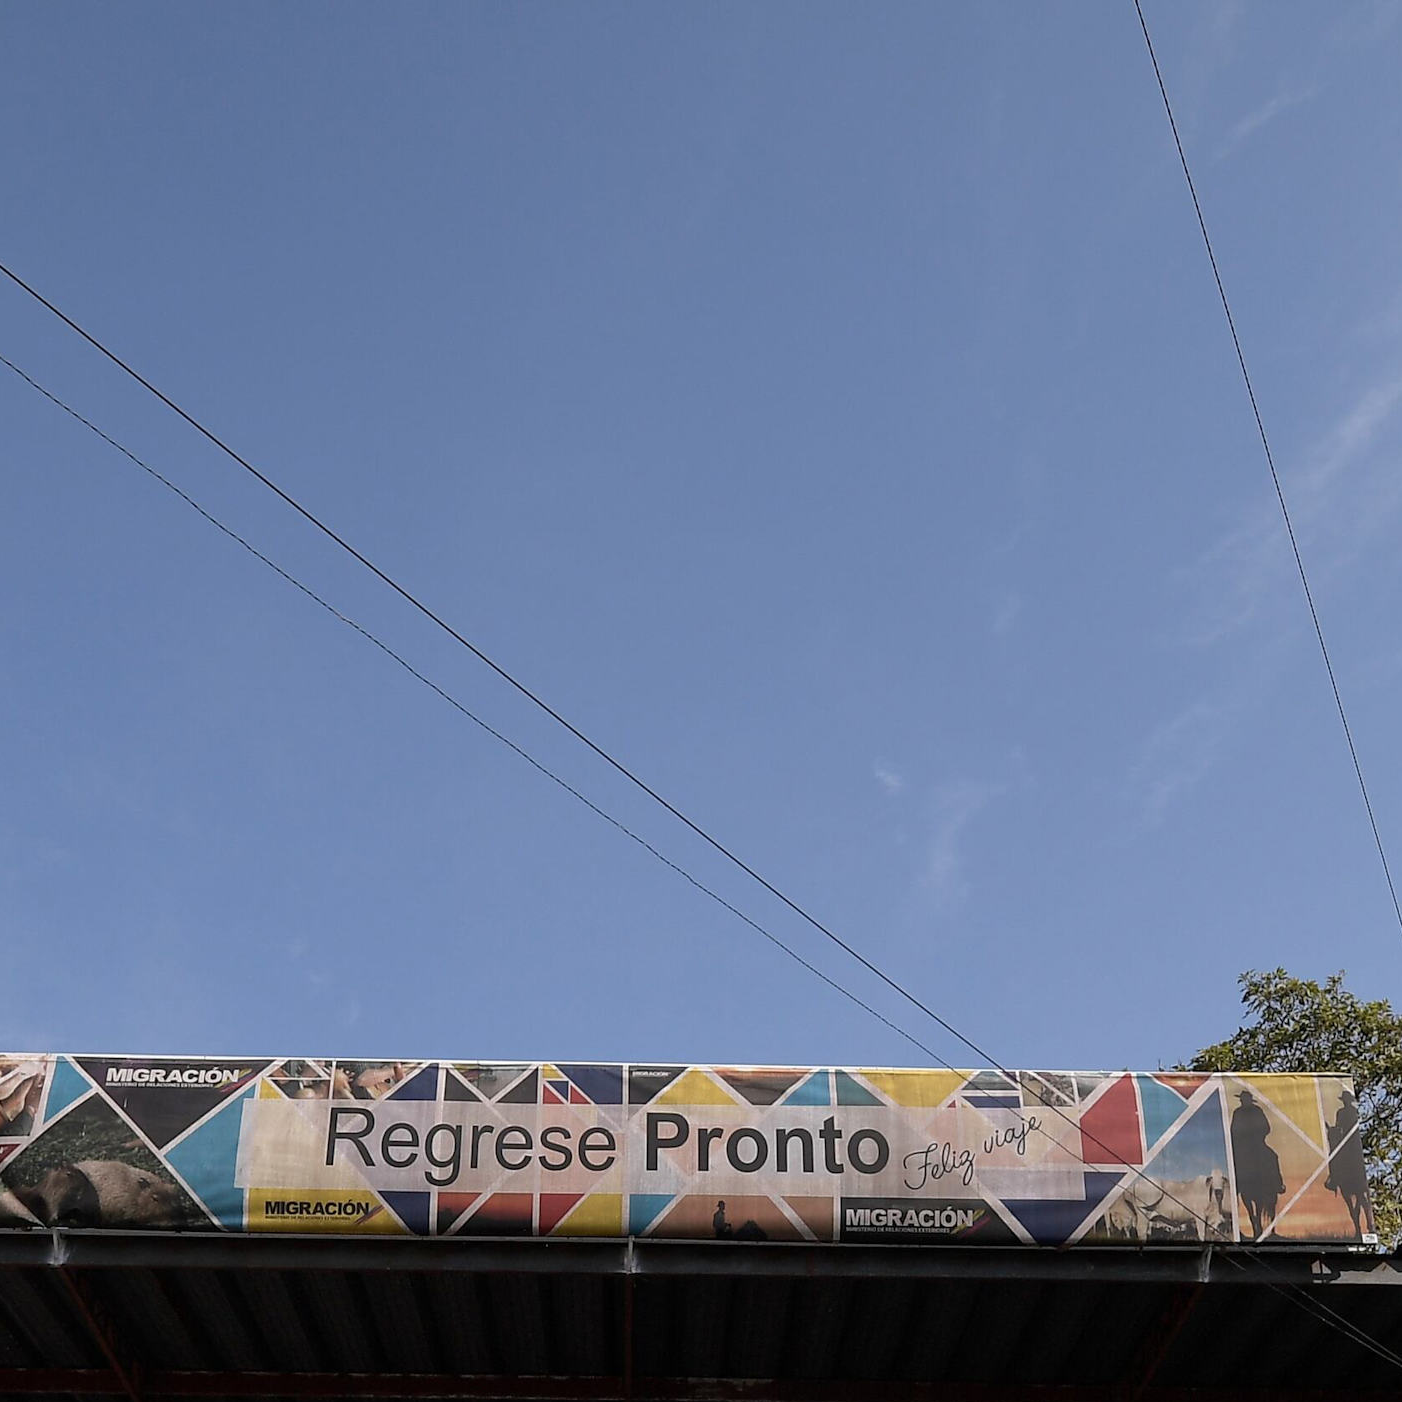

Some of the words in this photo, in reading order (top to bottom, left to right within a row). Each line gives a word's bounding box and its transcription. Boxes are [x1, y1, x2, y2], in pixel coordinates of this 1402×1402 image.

[105, 1065, 241, 1083] MIGRACIÓN
[324, 1106, 616, 1186] Regrese
[645, 1111, 890, 1175] Pronto
[902, 1142, 976, 1190] Feliz
[983, 1116, 1043, 1155] viaje
[265, 1199, 370, 1215] MIGRACIÓN
[845, 1206, 974, 1227] MIGRACIÓN
